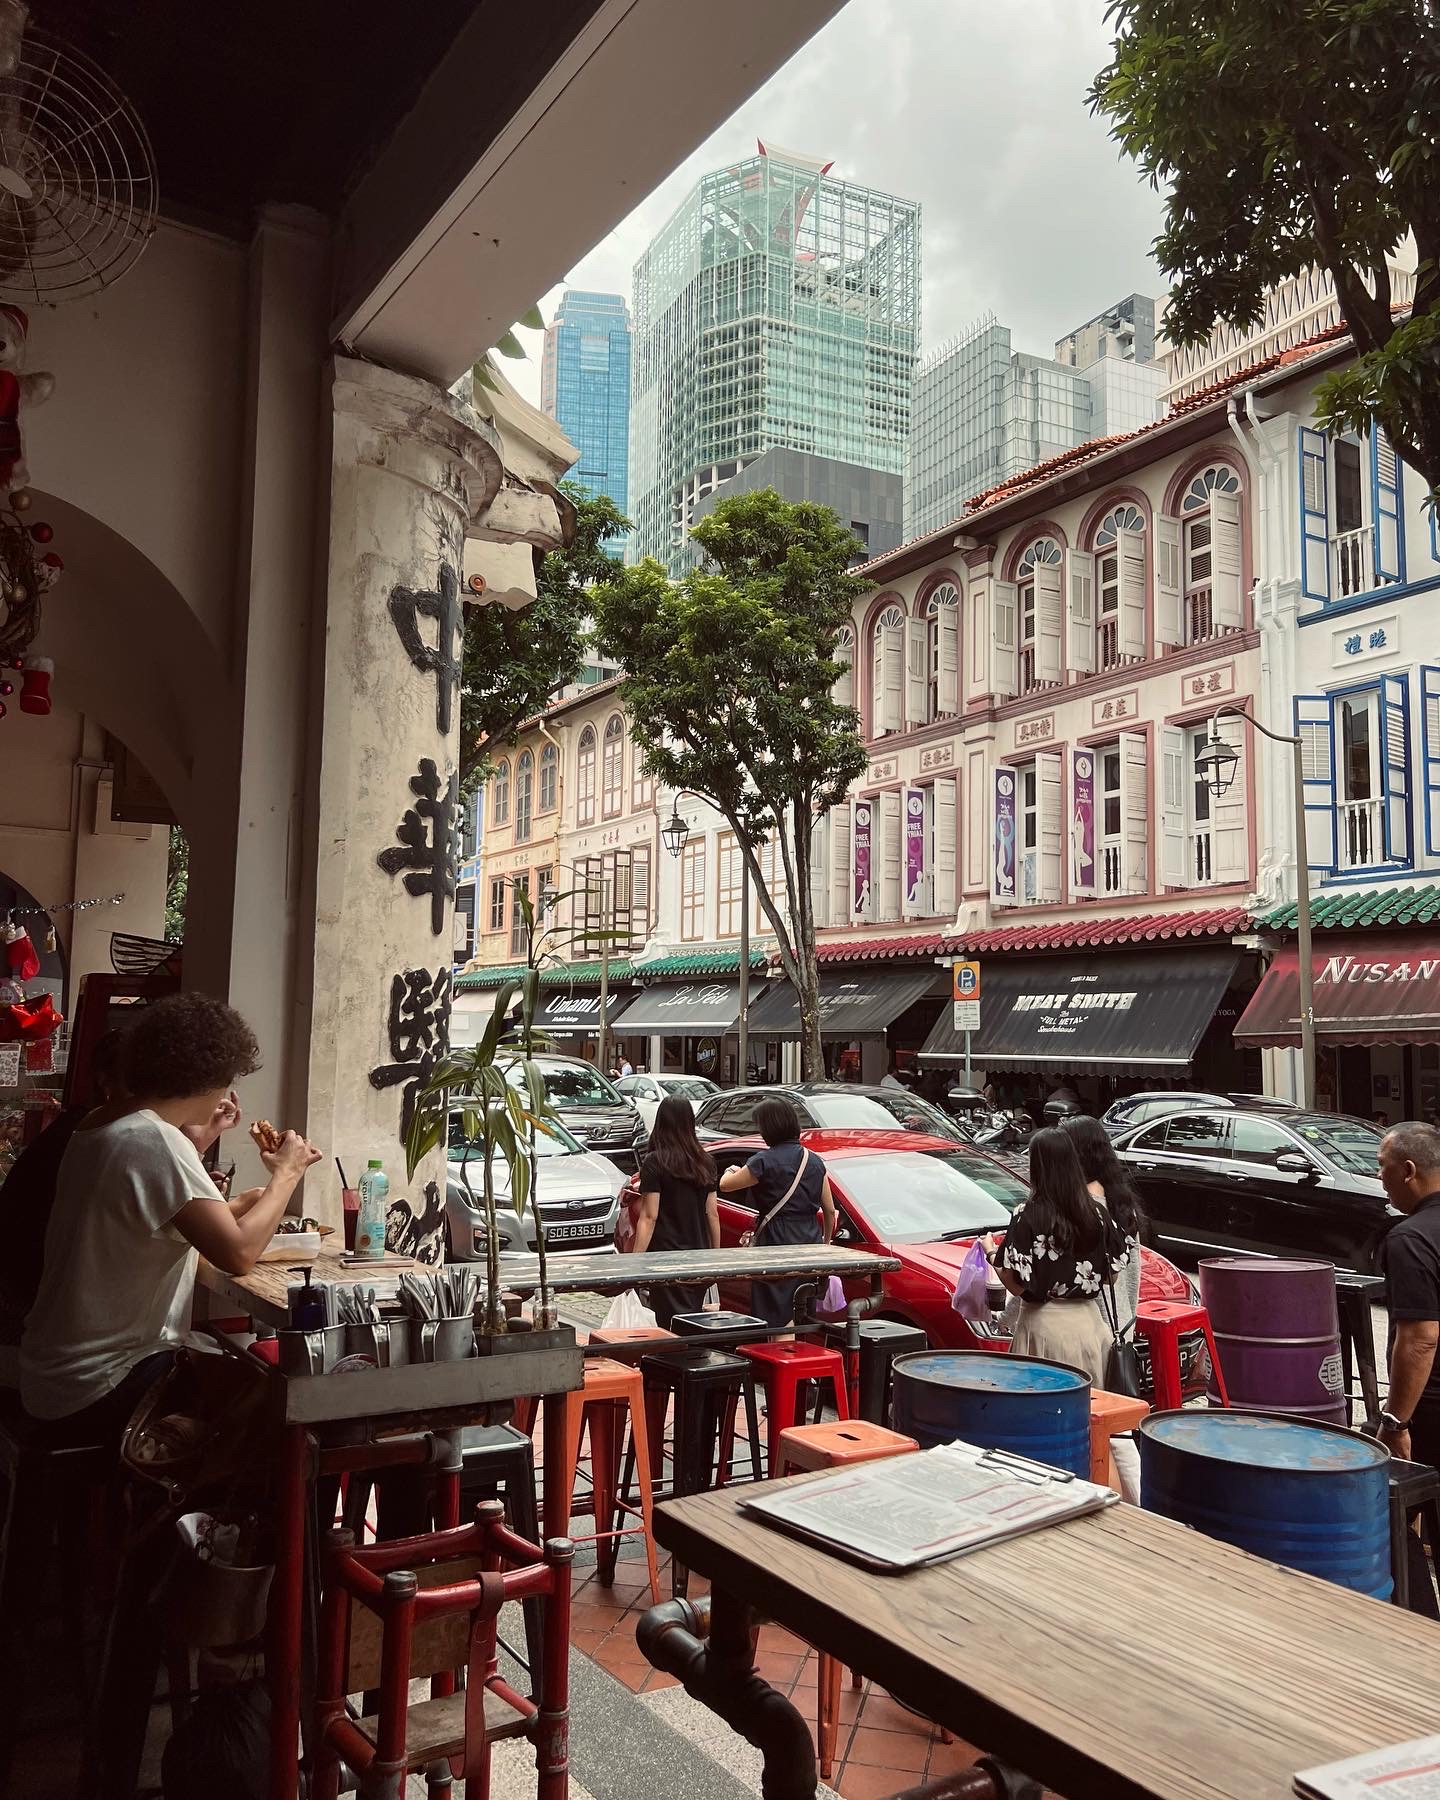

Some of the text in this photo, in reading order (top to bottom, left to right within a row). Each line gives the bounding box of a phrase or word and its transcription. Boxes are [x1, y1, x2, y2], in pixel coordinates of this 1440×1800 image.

[907, 822, 921, 831] FREE
[855, 833, 868, 842] FREE
[907, 830, 923, 839] TRIAL
[855, 840, 871, 849] TRIAL
[1012, 992, 1138, 1011] MEAT SMITH
[550, 1224, 604, 1238] SDE8363B
